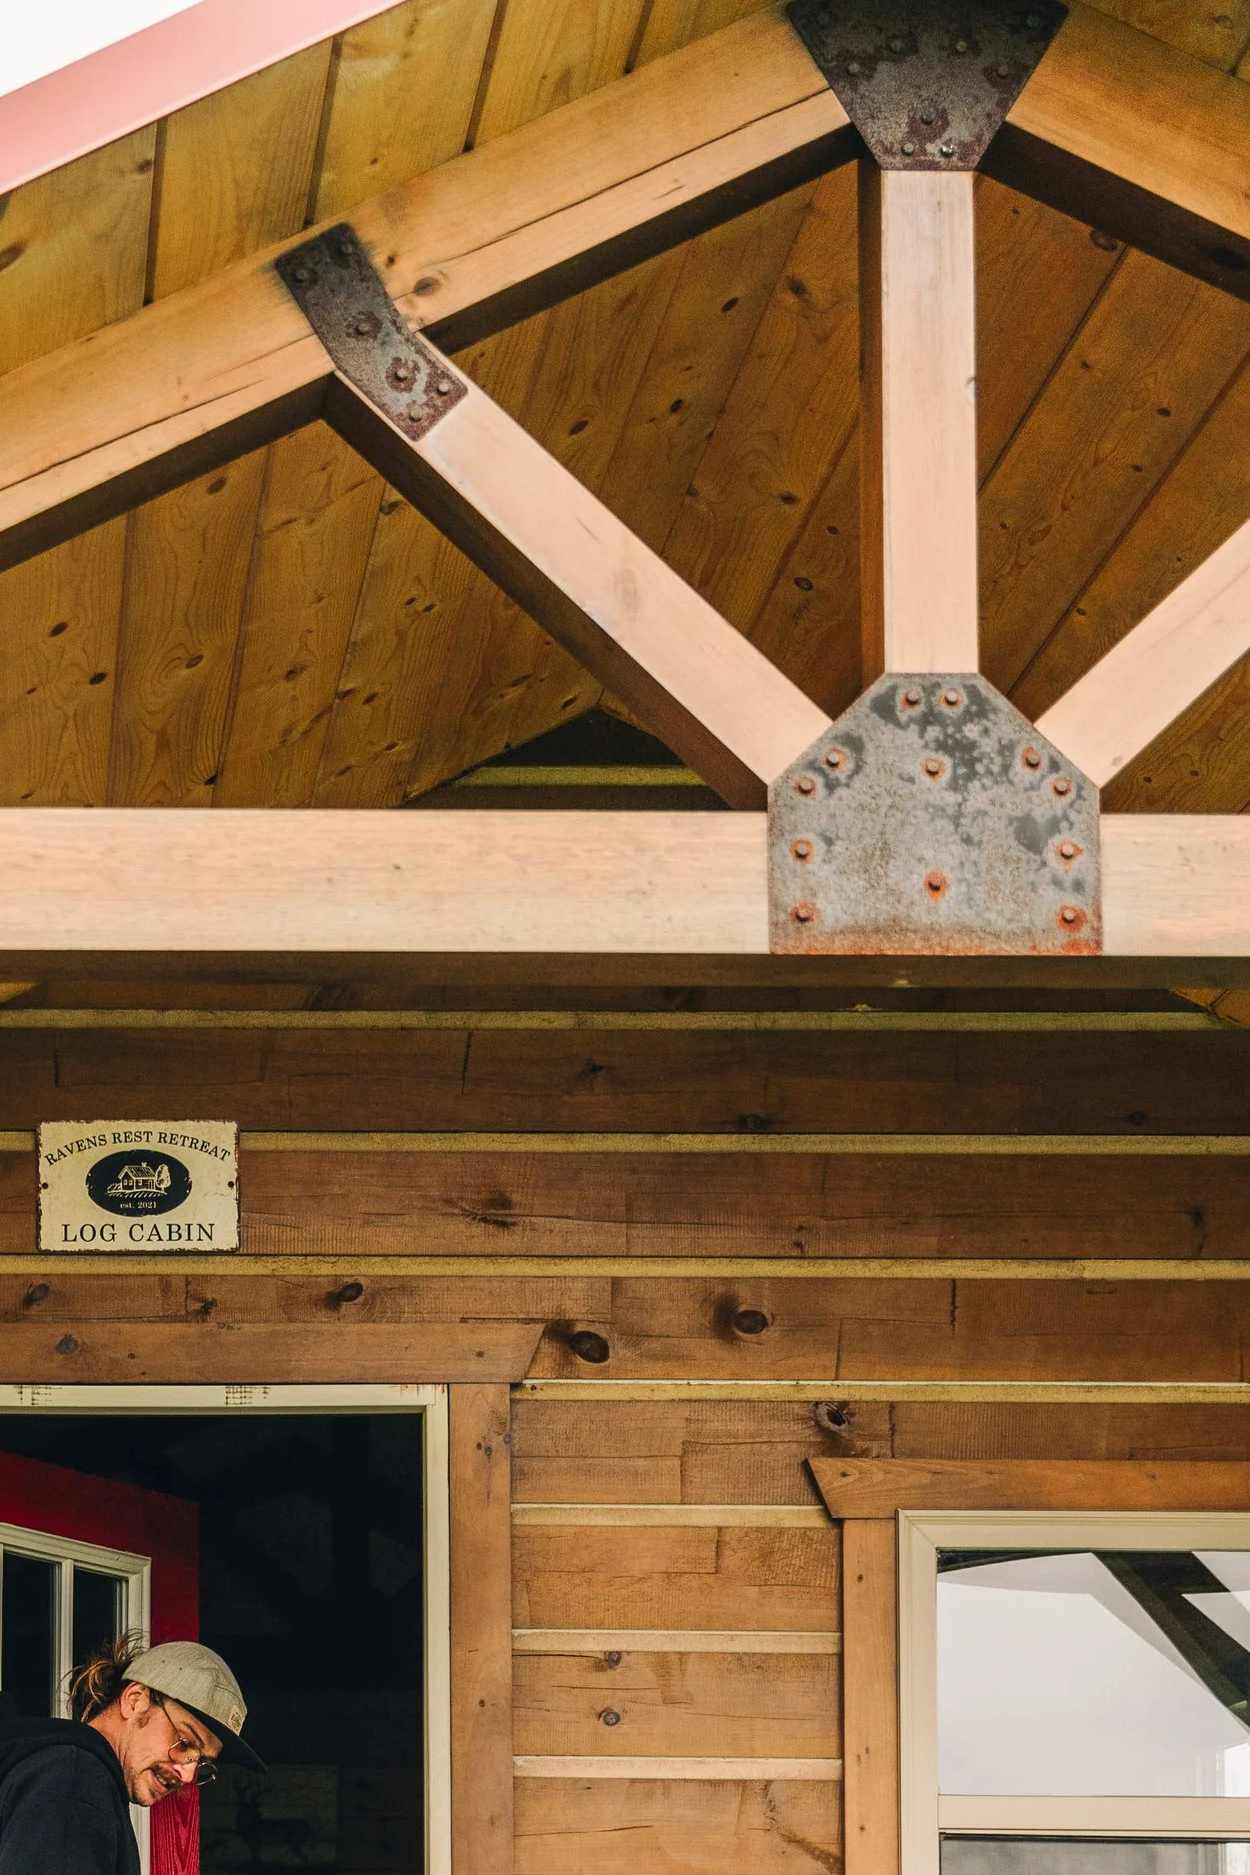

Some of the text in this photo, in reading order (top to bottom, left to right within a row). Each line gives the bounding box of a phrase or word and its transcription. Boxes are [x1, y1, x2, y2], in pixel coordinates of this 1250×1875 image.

[44, 1131, 231, 1167] RAVENS REST RETREAT
[137, 1201, 157, 1209] 2021
[61, 1223, 215, 1242] LOG CABIN
